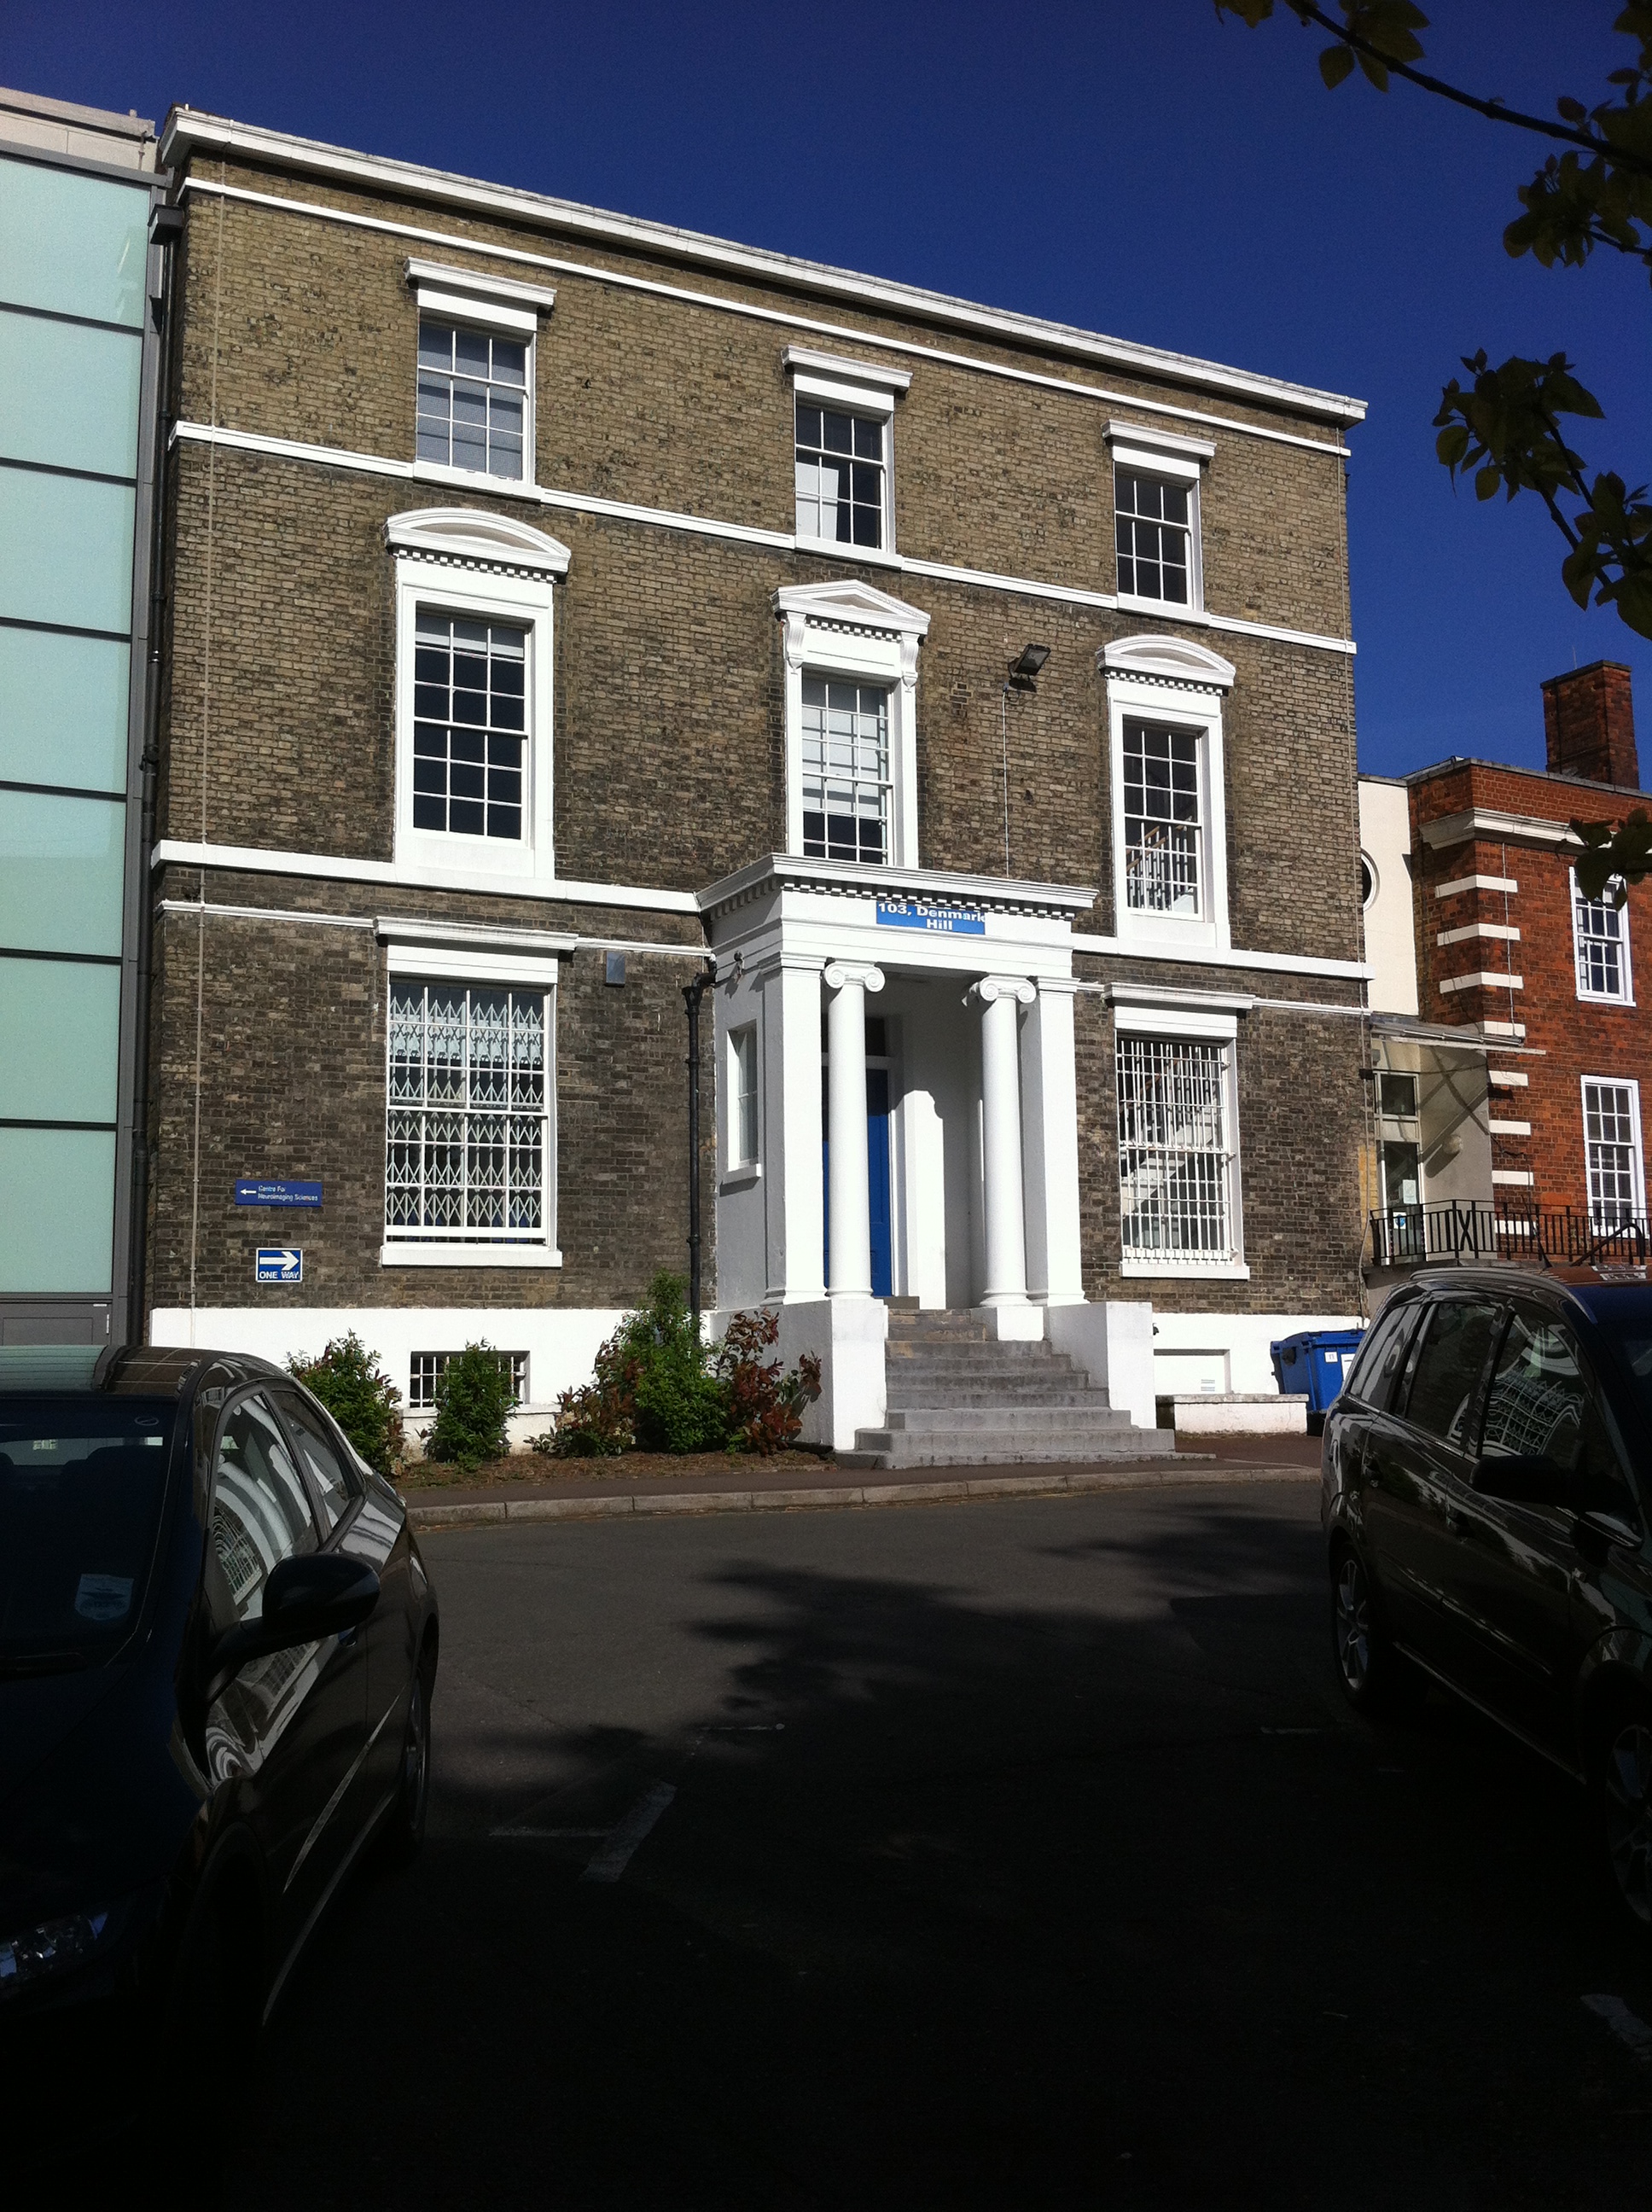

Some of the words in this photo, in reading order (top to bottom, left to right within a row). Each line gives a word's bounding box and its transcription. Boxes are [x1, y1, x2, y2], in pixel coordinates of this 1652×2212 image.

[878, 903, 912, 917] 103,
[926, 918, 953, 930] Hill
[258, 1193, 294, 1202] Neuroimaging
[259, 1271, 278, 1279] ONE
[281, 1271, 300, 1279] WAY
